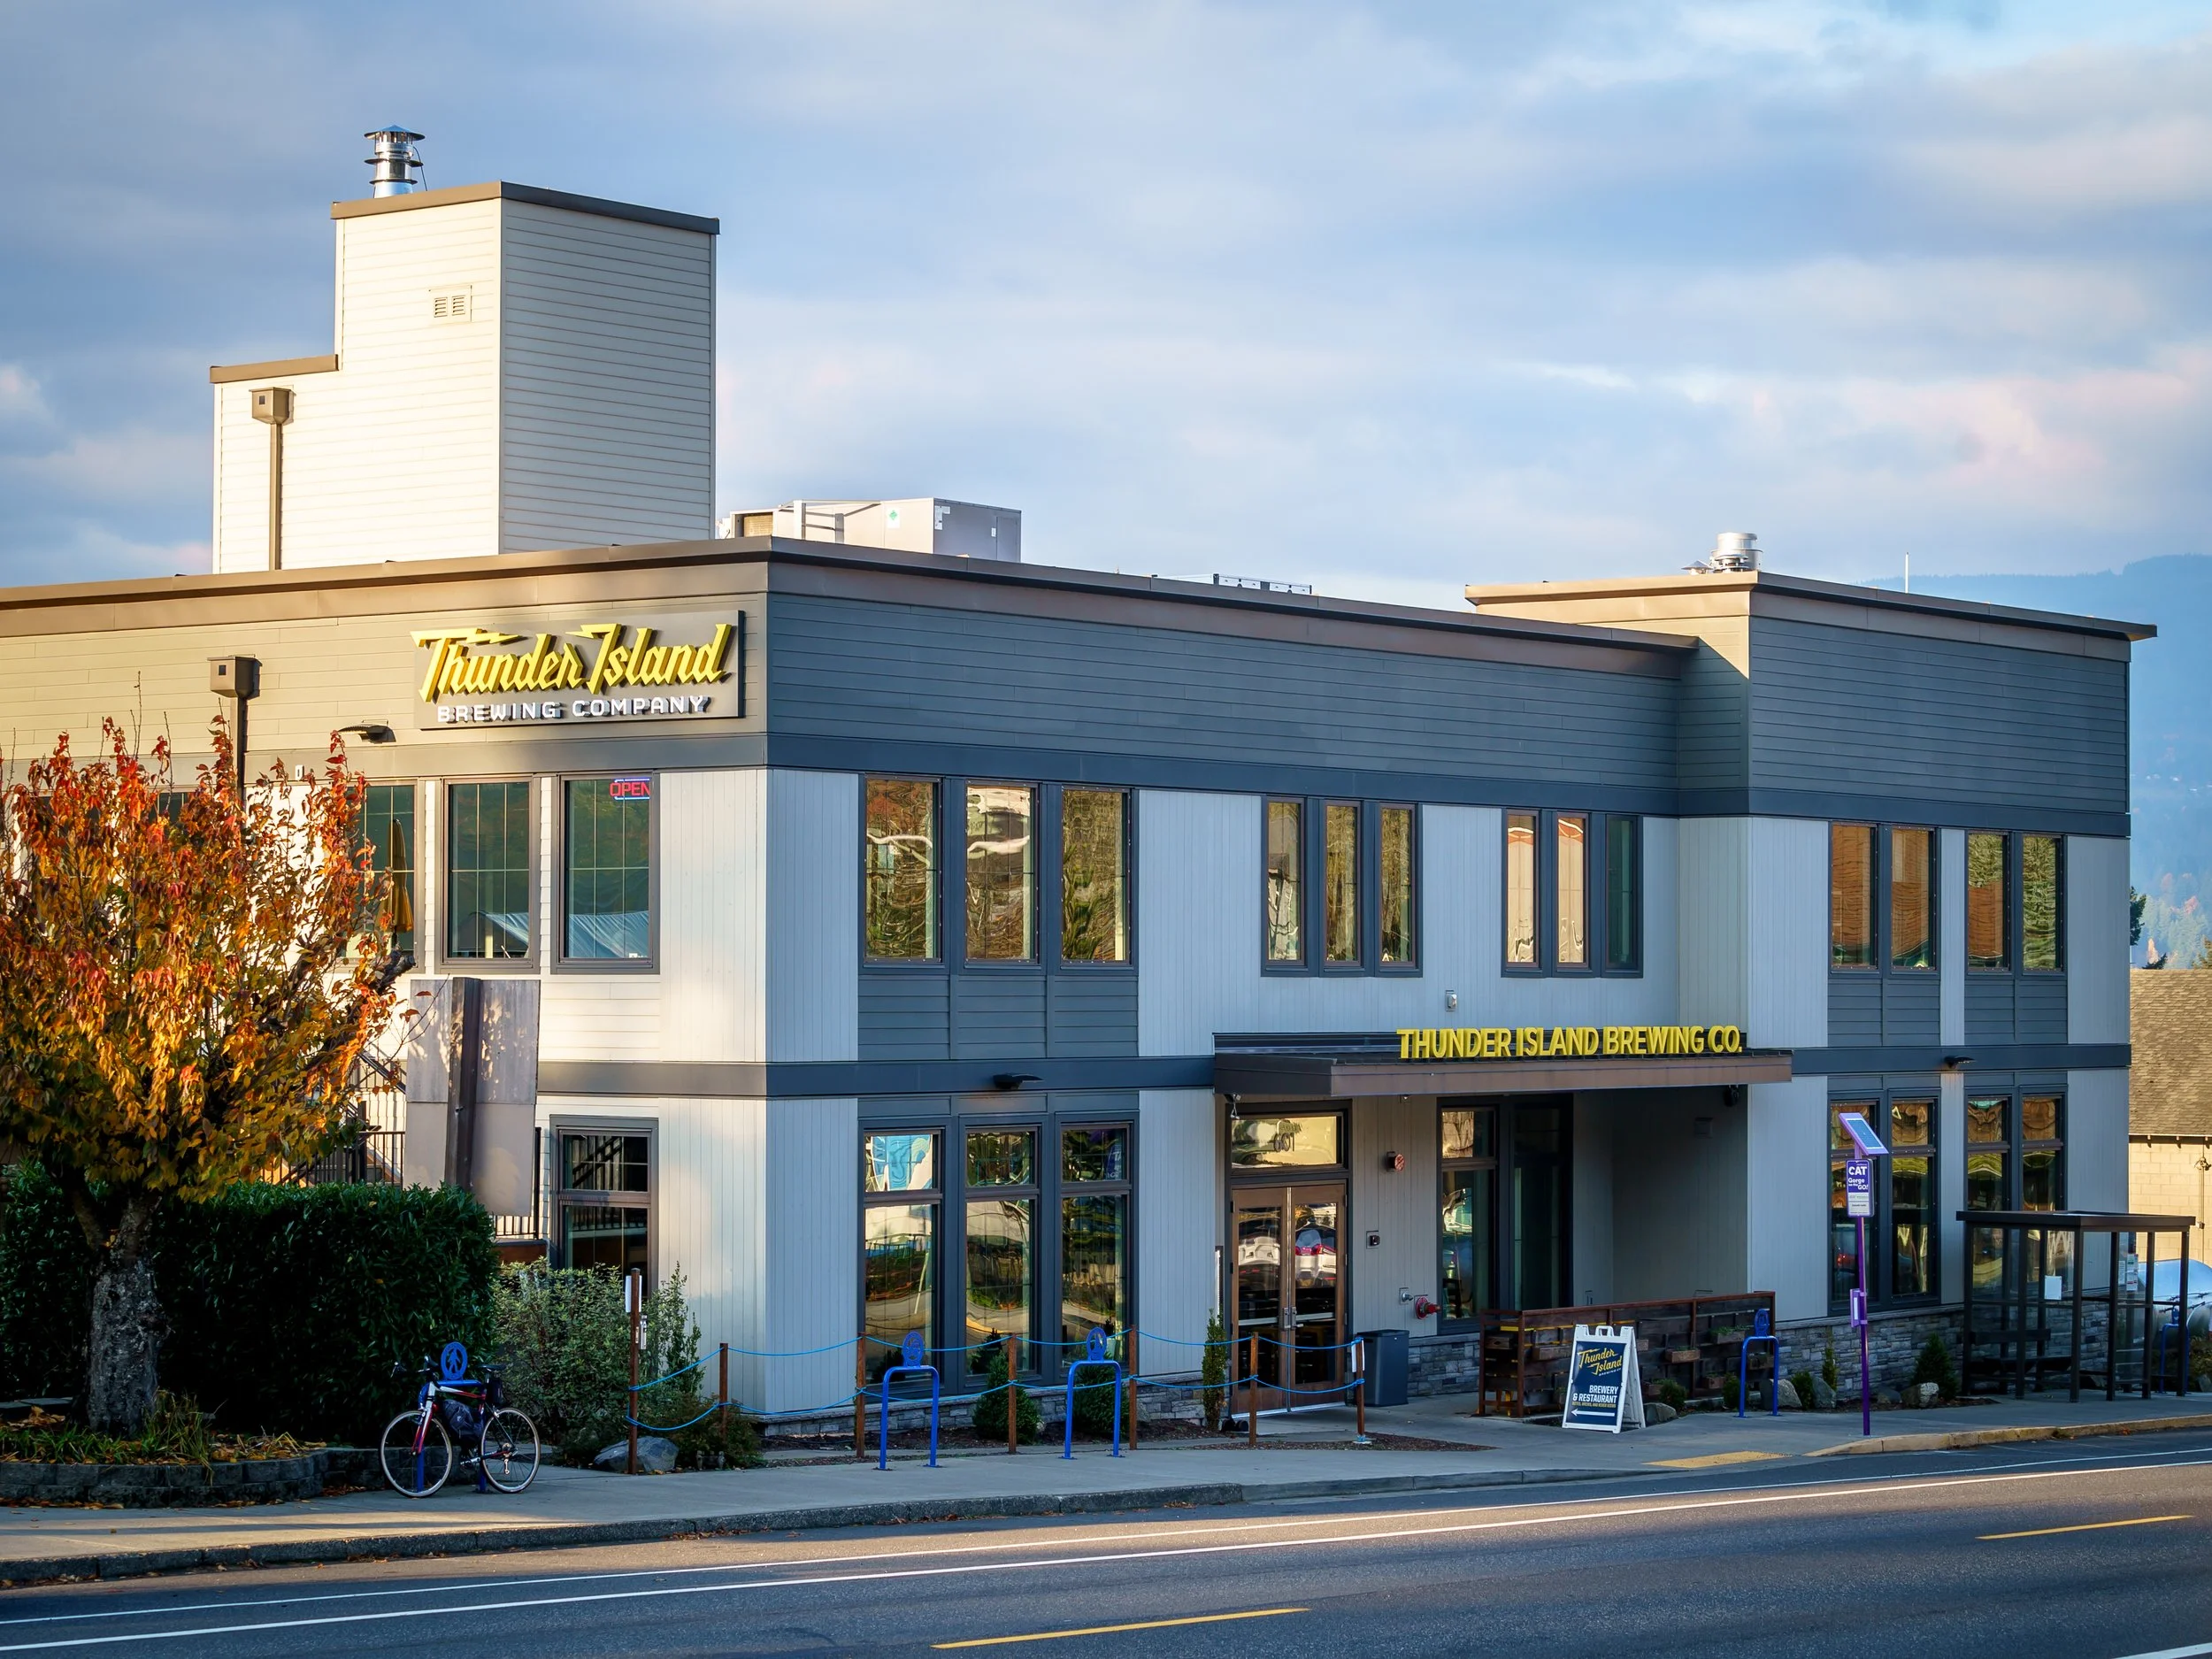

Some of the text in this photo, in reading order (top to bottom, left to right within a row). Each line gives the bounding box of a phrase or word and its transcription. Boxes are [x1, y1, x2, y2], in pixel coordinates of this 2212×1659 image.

[411, 623, 729, 703] Thunder Island
[437, 695, 710, 723] BREWING COMPANY
[610, 782, 650, 796] OPEN
[1396, 1025, 1742, 1058] THUNDER ISLAND BREWING CO.
[1849, 1166, 1867, 1175] CAT
[1577, 1348, 1618, 1368] Thunder
[1586, 1356, 1623, 1376] Island
[1572, 1392, 1617, 1403] & RESTAURANT
[1589, 1385, 1619, 1394] BREWERY
